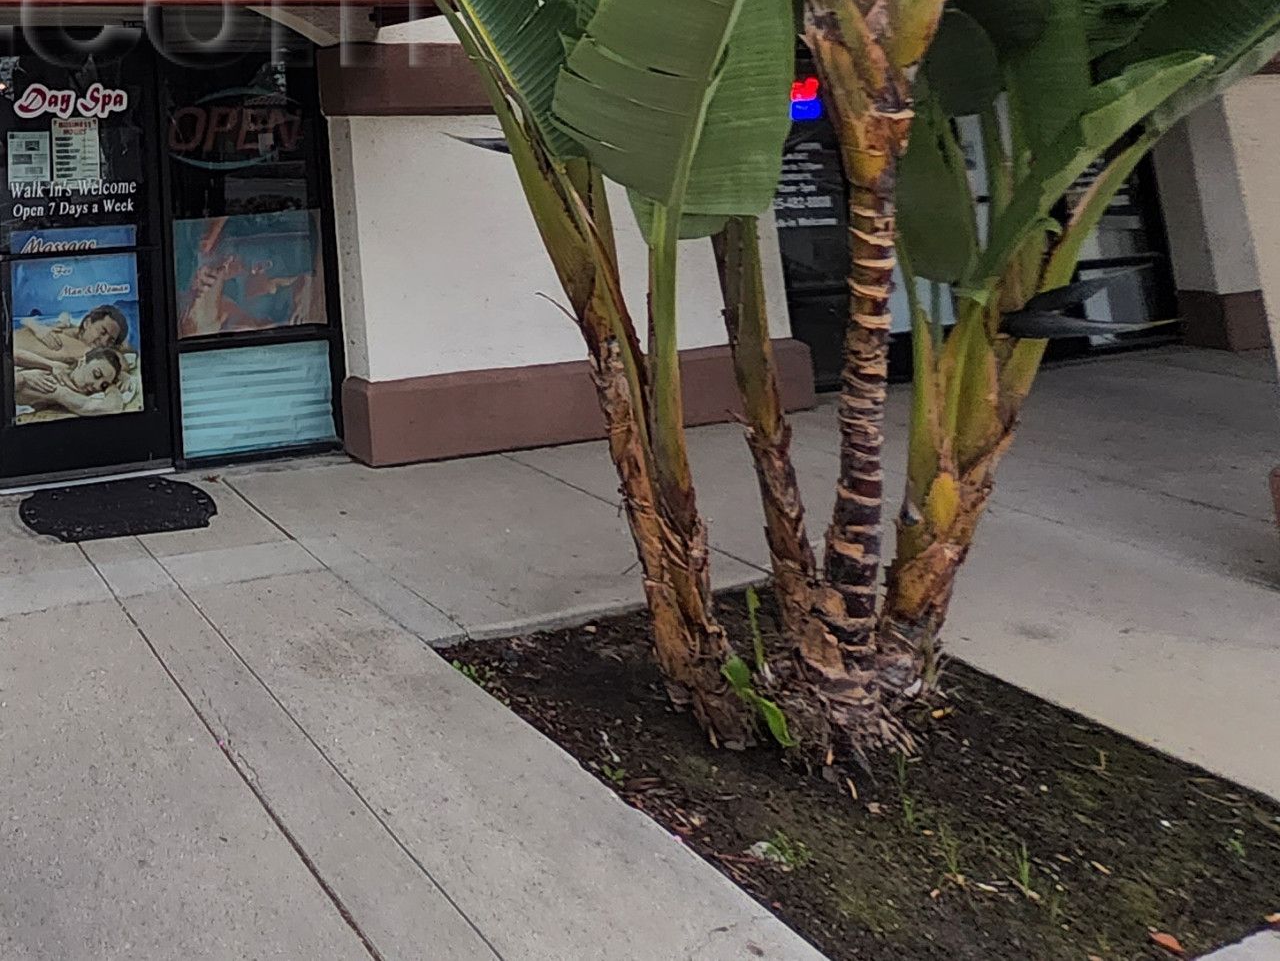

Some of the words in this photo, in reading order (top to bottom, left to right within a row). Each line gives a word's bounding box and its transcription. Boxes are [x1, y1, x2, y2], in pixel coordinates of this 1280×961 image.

[15, 84, 76, 118] Day
[77, 84, 128, 118] Spa
[168, 106, 304, 151] OPEN
[10, 180, 45, 198] Walk
[49, 180, 73, 197] In's
[78, 179, 136, 196] Welcome
[13, 204, 44, 220] Open
[48, 202, 56, 215] 7
[59, 202, 89, 217] Days
[92, 204, 99, 213] a
[103, 198, 134, 212] Week
